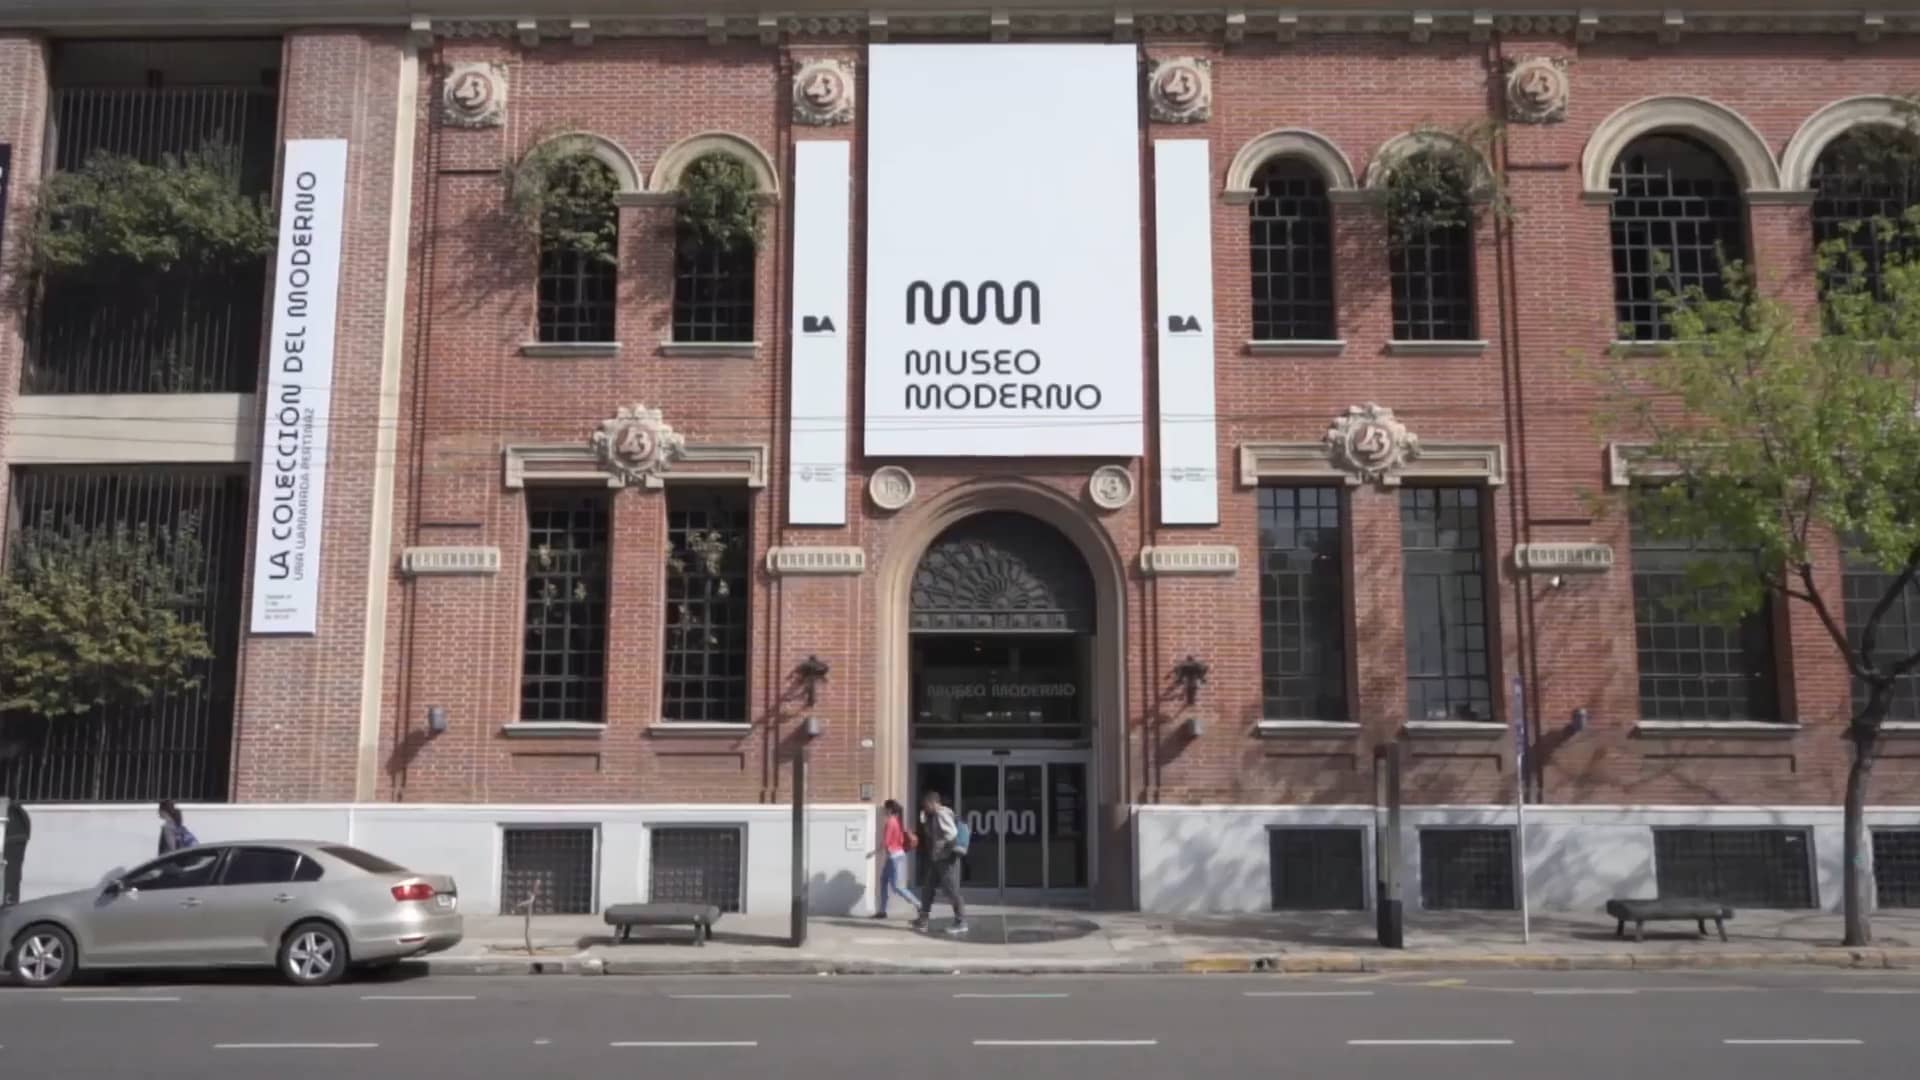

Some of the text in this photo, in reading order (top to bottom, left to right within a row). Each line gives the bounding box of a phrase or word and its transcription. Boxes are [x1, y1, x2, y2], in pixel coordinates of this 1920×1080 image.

[287, 171, 316, 317] MODERNO
[803, 315, 836, 333] BA
[1168, 315, 1202, 333] BA
[283, 326, 306, 373] DEL
[905, 350, 1041, 375] MUSEO
[905, 384, 1102, 409] MODERNO
[272, 384, 302, 541] COLECCIÓN
[269, 551, 290, 579] LA
